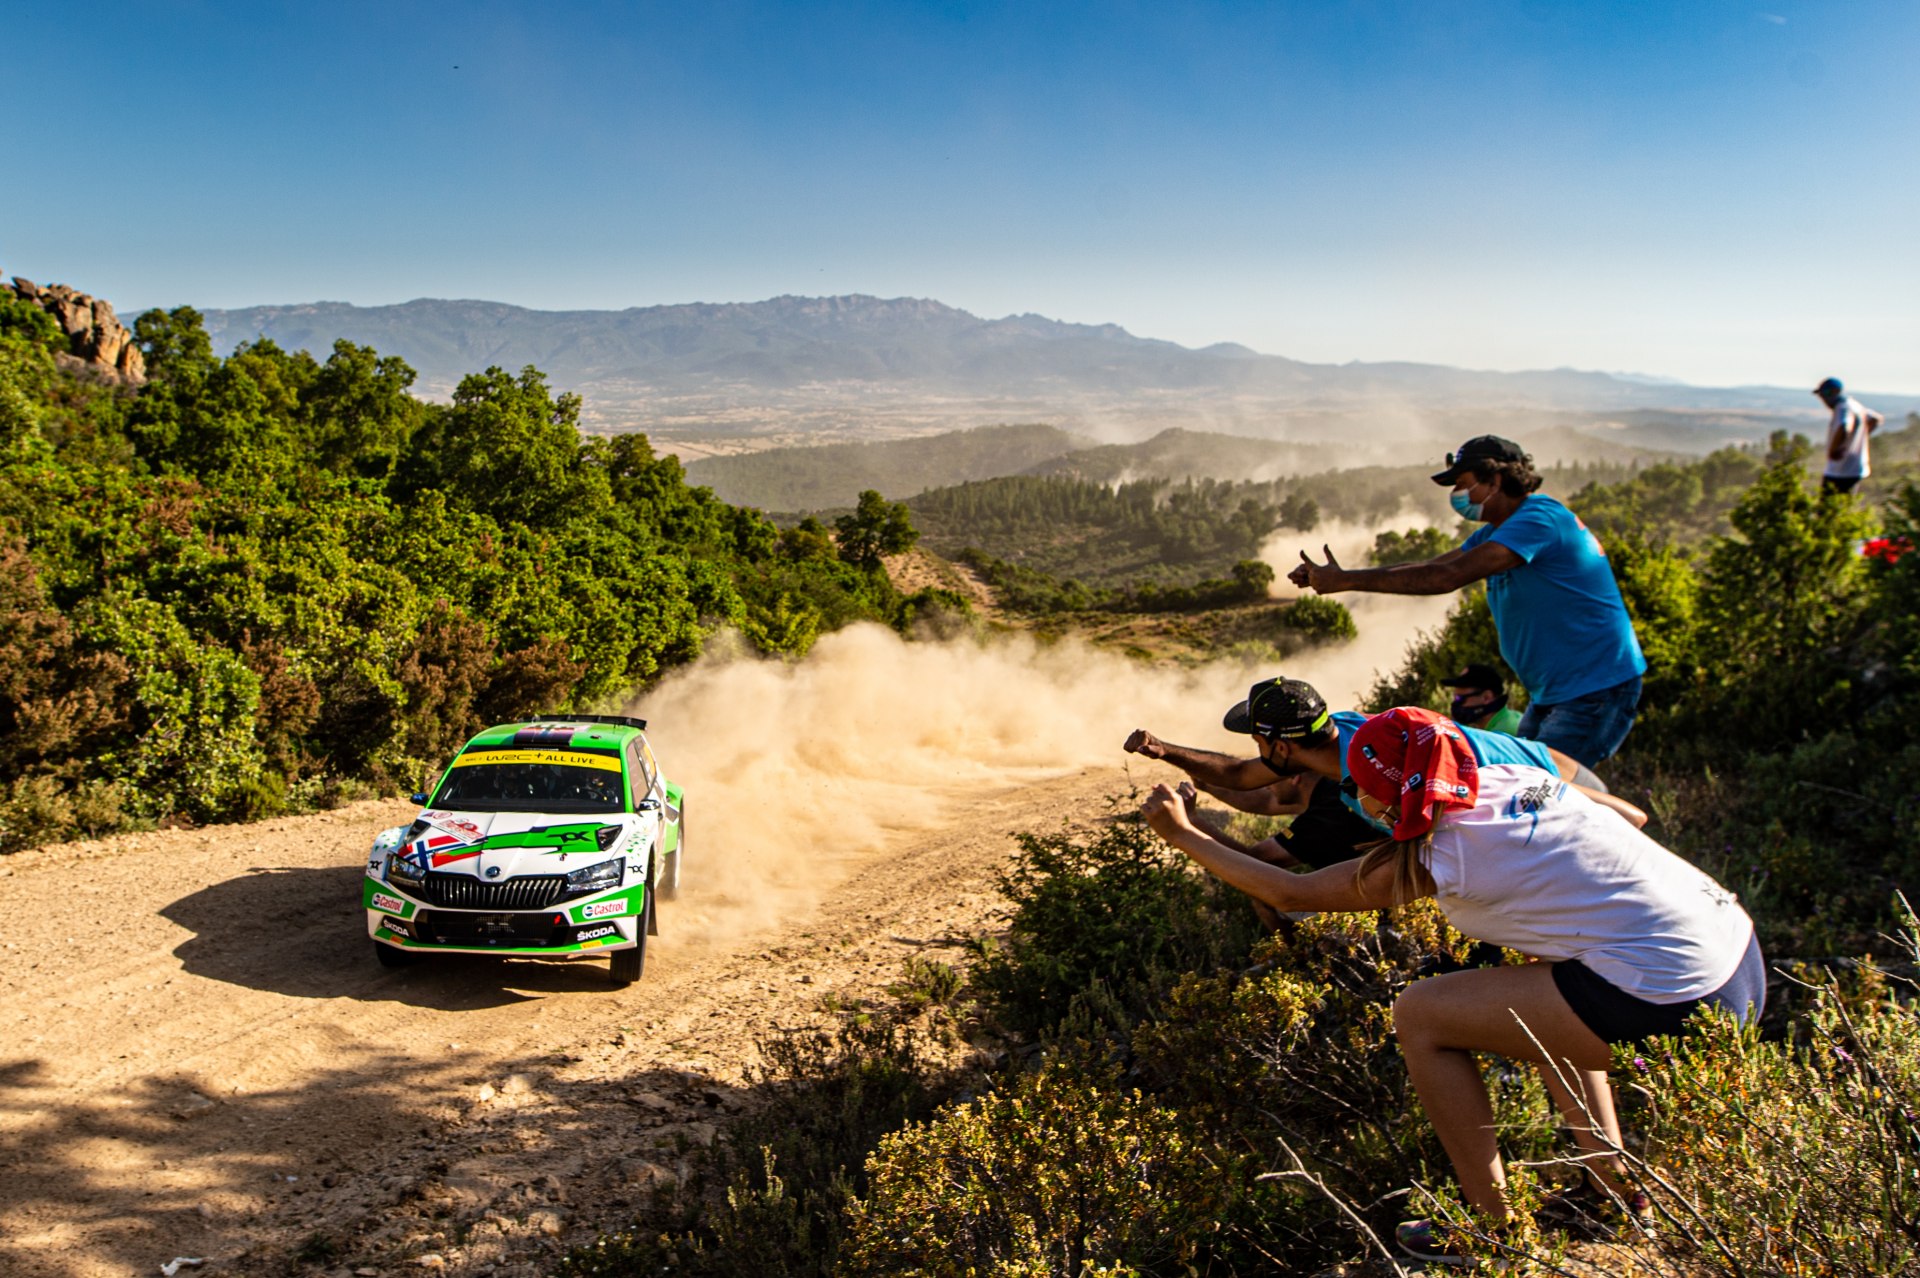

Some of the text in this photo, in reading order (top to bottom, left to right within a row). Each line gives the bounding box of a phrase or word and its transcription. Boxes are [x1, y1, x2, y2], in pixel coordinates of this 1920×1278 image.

[545, 755, 567, 763] ALL
[570, 756, 596, 765] LIVE
[380, 896, 402, 912] Castrol
[594, 901, 624, 916] Castrol
[577, 926, 616, 941] ŠKODA
